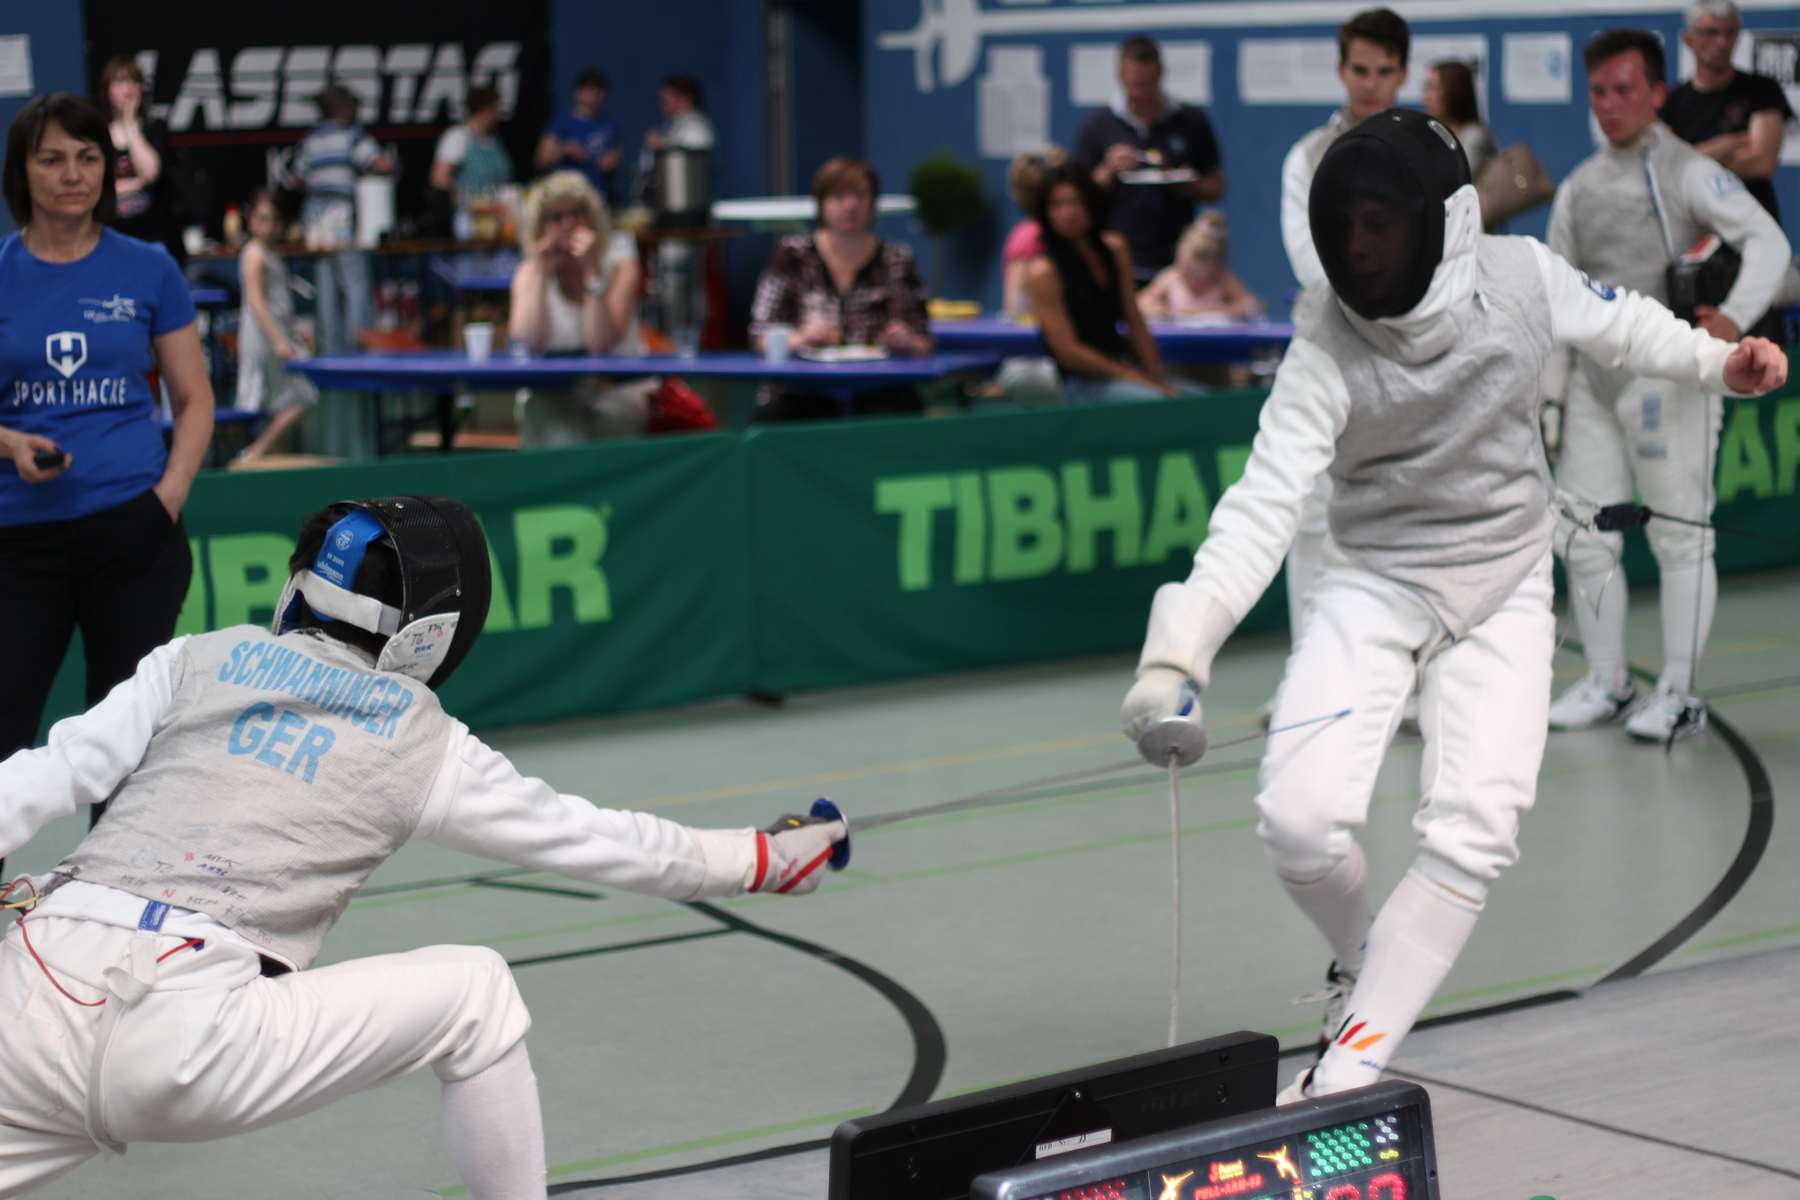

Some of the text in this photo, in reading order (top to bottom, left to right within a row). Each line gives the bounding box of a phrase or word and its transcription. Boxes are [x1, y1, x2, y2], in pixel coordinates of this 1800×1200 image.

[874, 444, 1252, 592] TIBHA
[217, 640, 414, 741] SCHWANNINGER
[227, 701, 337, 784] GER
